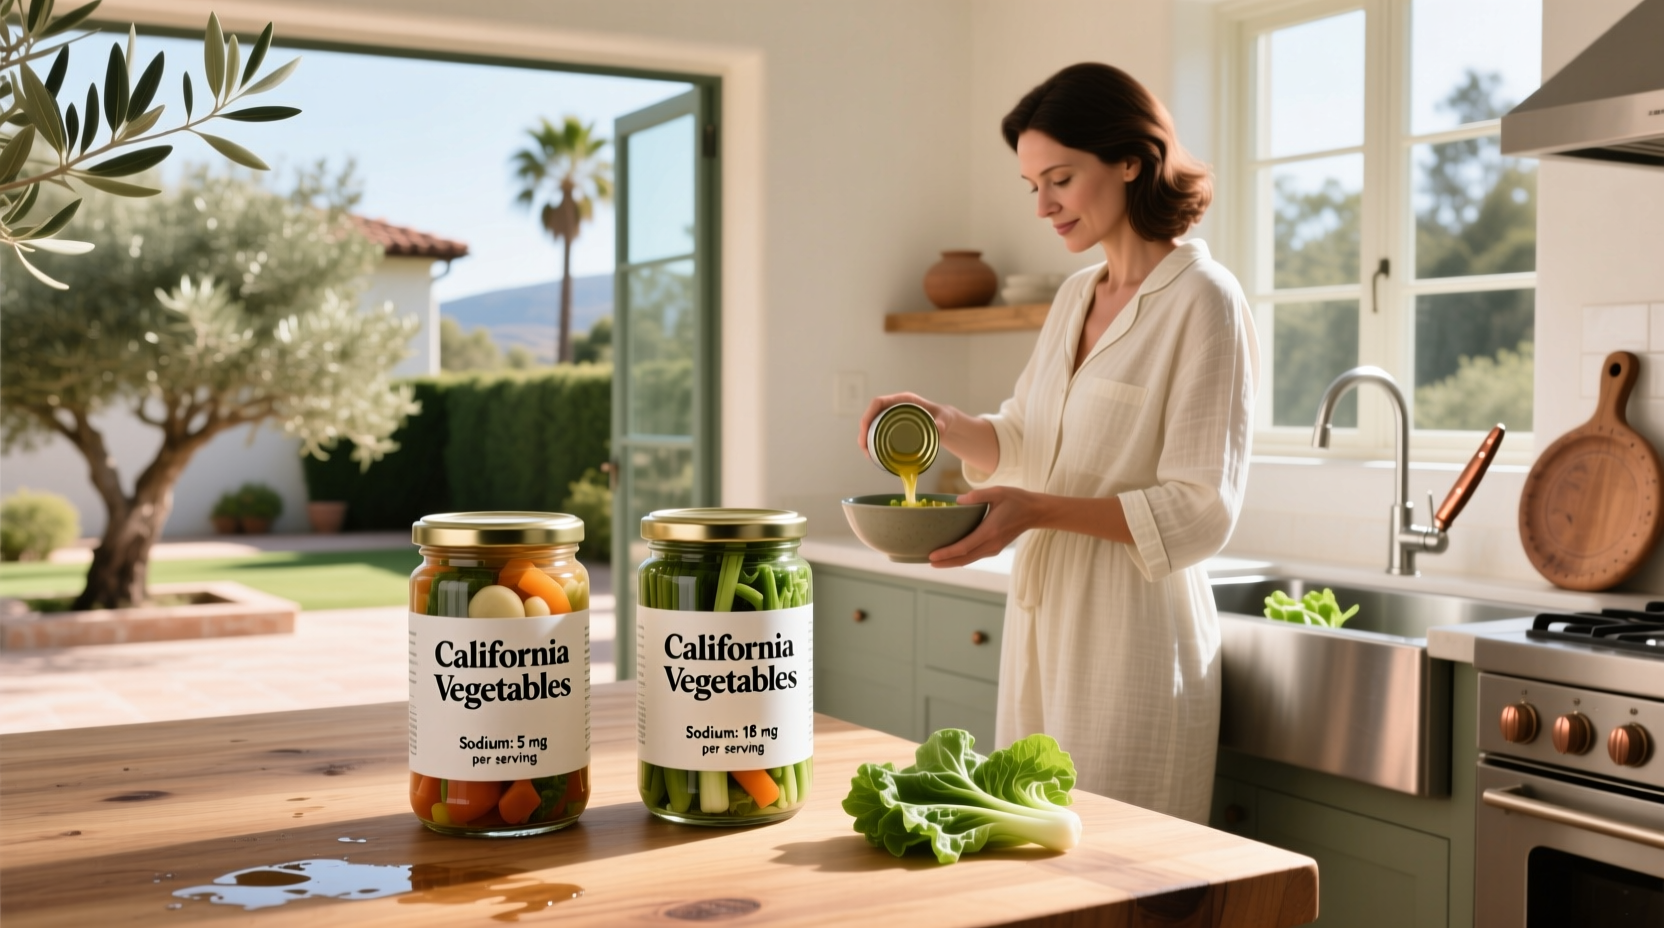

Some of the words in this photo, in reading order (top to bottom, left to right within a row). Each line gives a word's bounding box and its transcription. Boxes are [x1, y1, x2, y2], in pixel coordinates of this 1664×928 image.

[434, 638, 570, 669] California
[664, 632, 795, 661] California
[433, 671, 572, 710] Vegetables
[663, 664, 798, 701] Vegetables
[459, 735, 514, 750] Sodium:
[517, 735, 525, 749] 5
[529, 736, 548, 751] mg
[686, 725, 739, 739] Sodium:
[761, 726, 778, 740] mg
[472, 755, 492, 767] per
[495, 752, 538, 766] serving
[702, 745, 720, 756] per
[724, 741, 765, 756] serving
